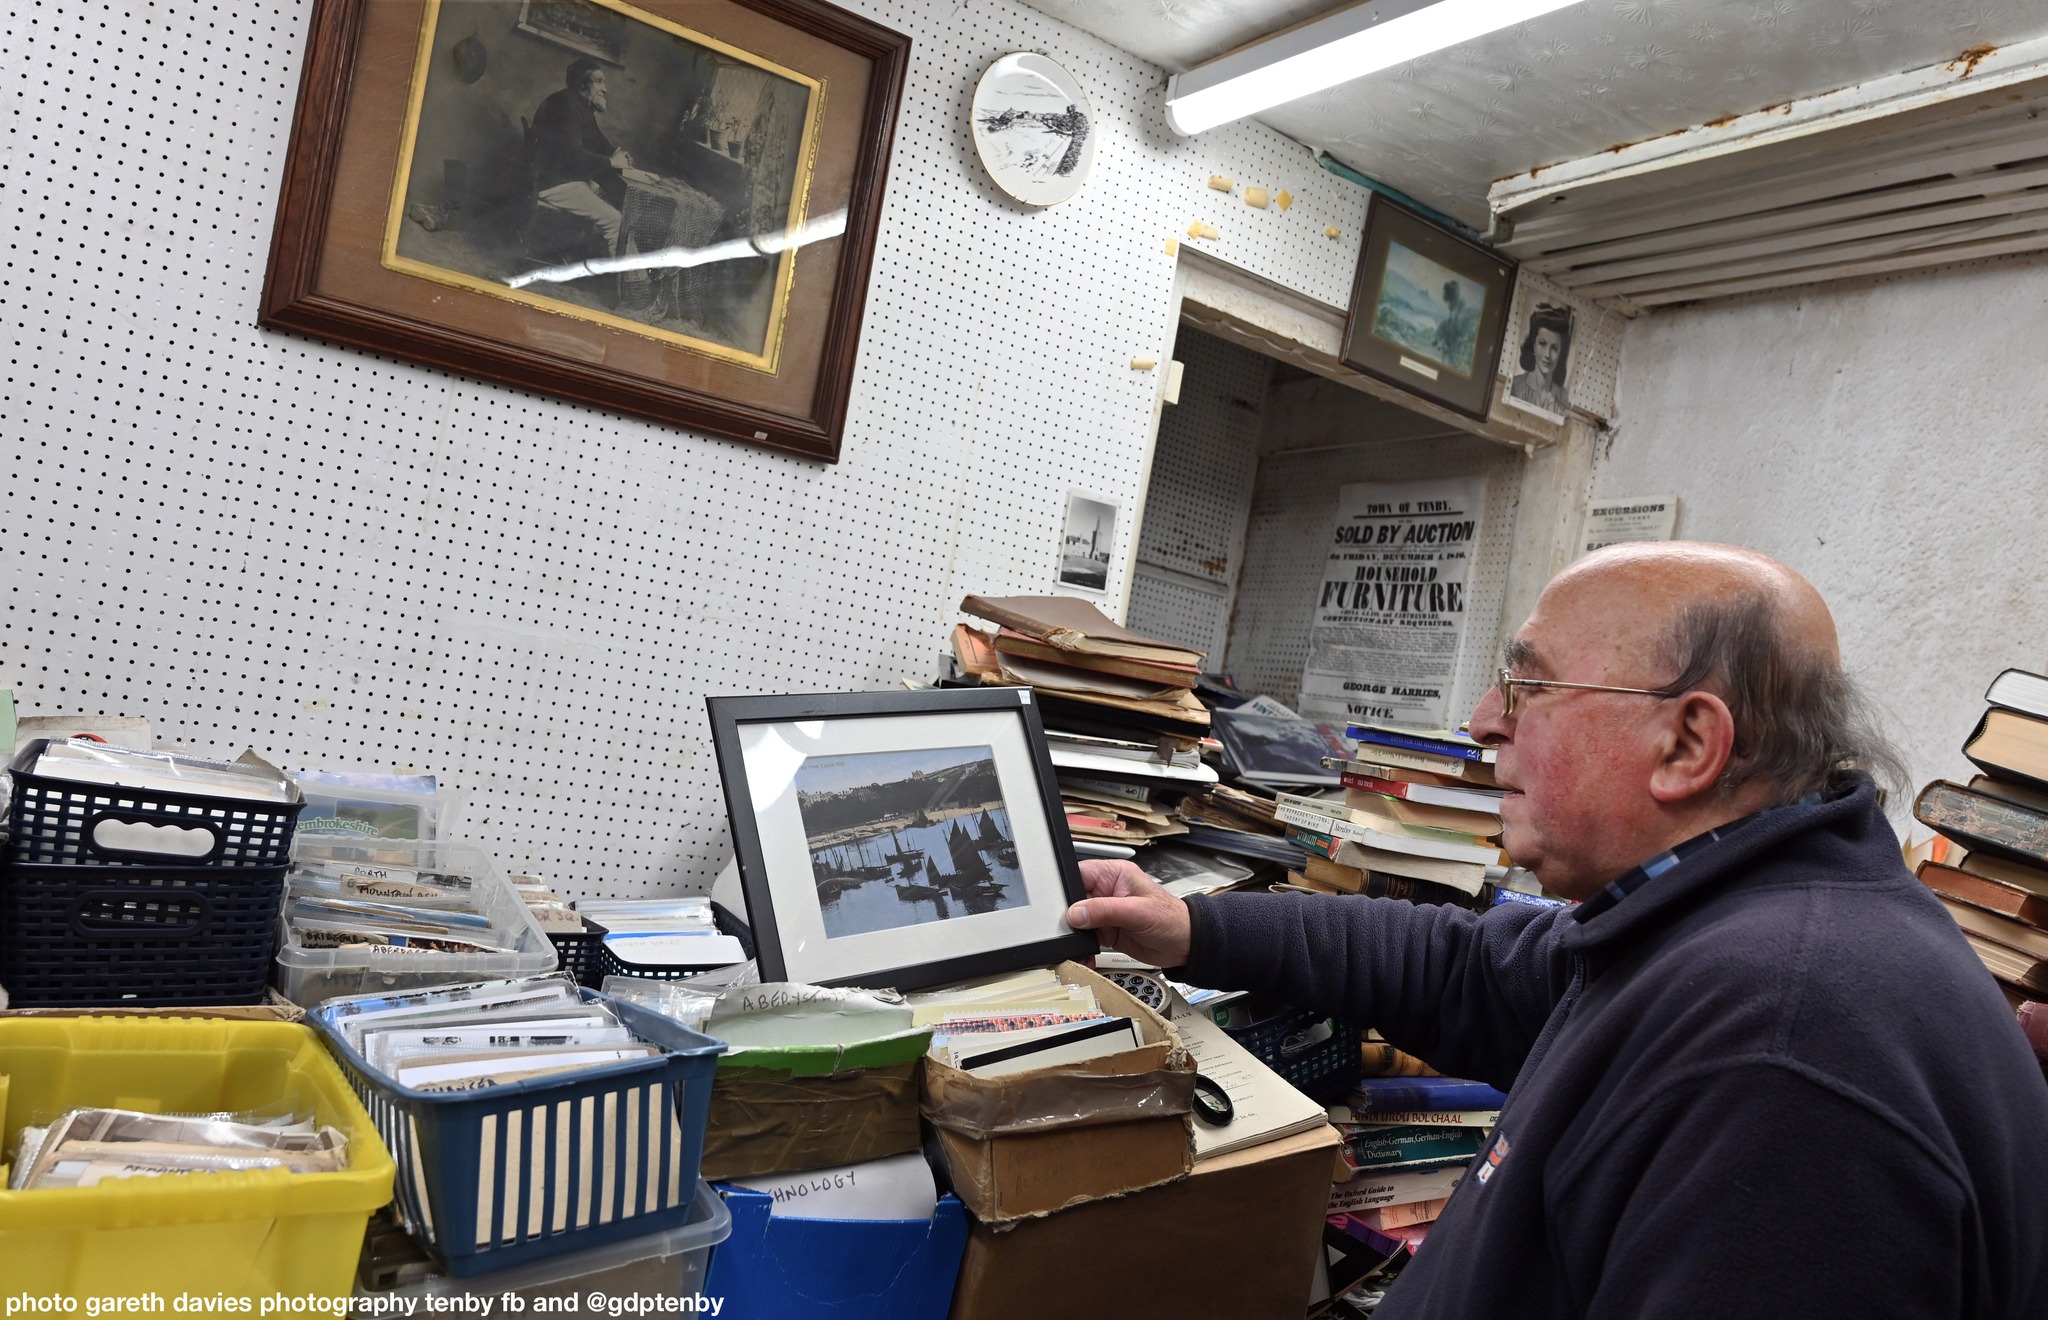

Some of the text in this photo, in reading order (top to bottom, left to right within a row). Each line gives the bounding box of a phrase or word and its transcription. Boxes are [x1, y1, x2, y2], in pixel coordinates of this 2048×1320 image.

[1399, 502, 1411, 513] OF
[1592, 504, 1665, 516] EXCURSIONS
[1334, 521, 1475, 544] SOLD BY AUCTION
[1383, 553, 1434, 561] DECEMBER
[1355, 566, 1438, 582] HOUSEHOLD
[1319, 580, 1463, 612] FURNITURE
[1343, 682, 1386, 695] GEORGE
[1391, 687, 1441, 700] HARRIES,
[1345, 704, 1394, 719] NOTICE.
[1284, 814, 1300, 823] THEORY
[1286, 807, 1330, 825] REPRESENTATIONAL
[297, 816, 379, 836] embrokeshire
[358, 886, 413, 899] MOUNTAIN
[1350, 1110, 1463, 1124] HINDI URDU BOL CHAAL
[1366, 1148, 1402, 1159] Dictionary
[766, 1171, 856, 1204] HNOLOGY
[1330, 1184, 1394, 1200] The Oxford Guide to
[1327, 1194, 1395, 1210] the English Language
